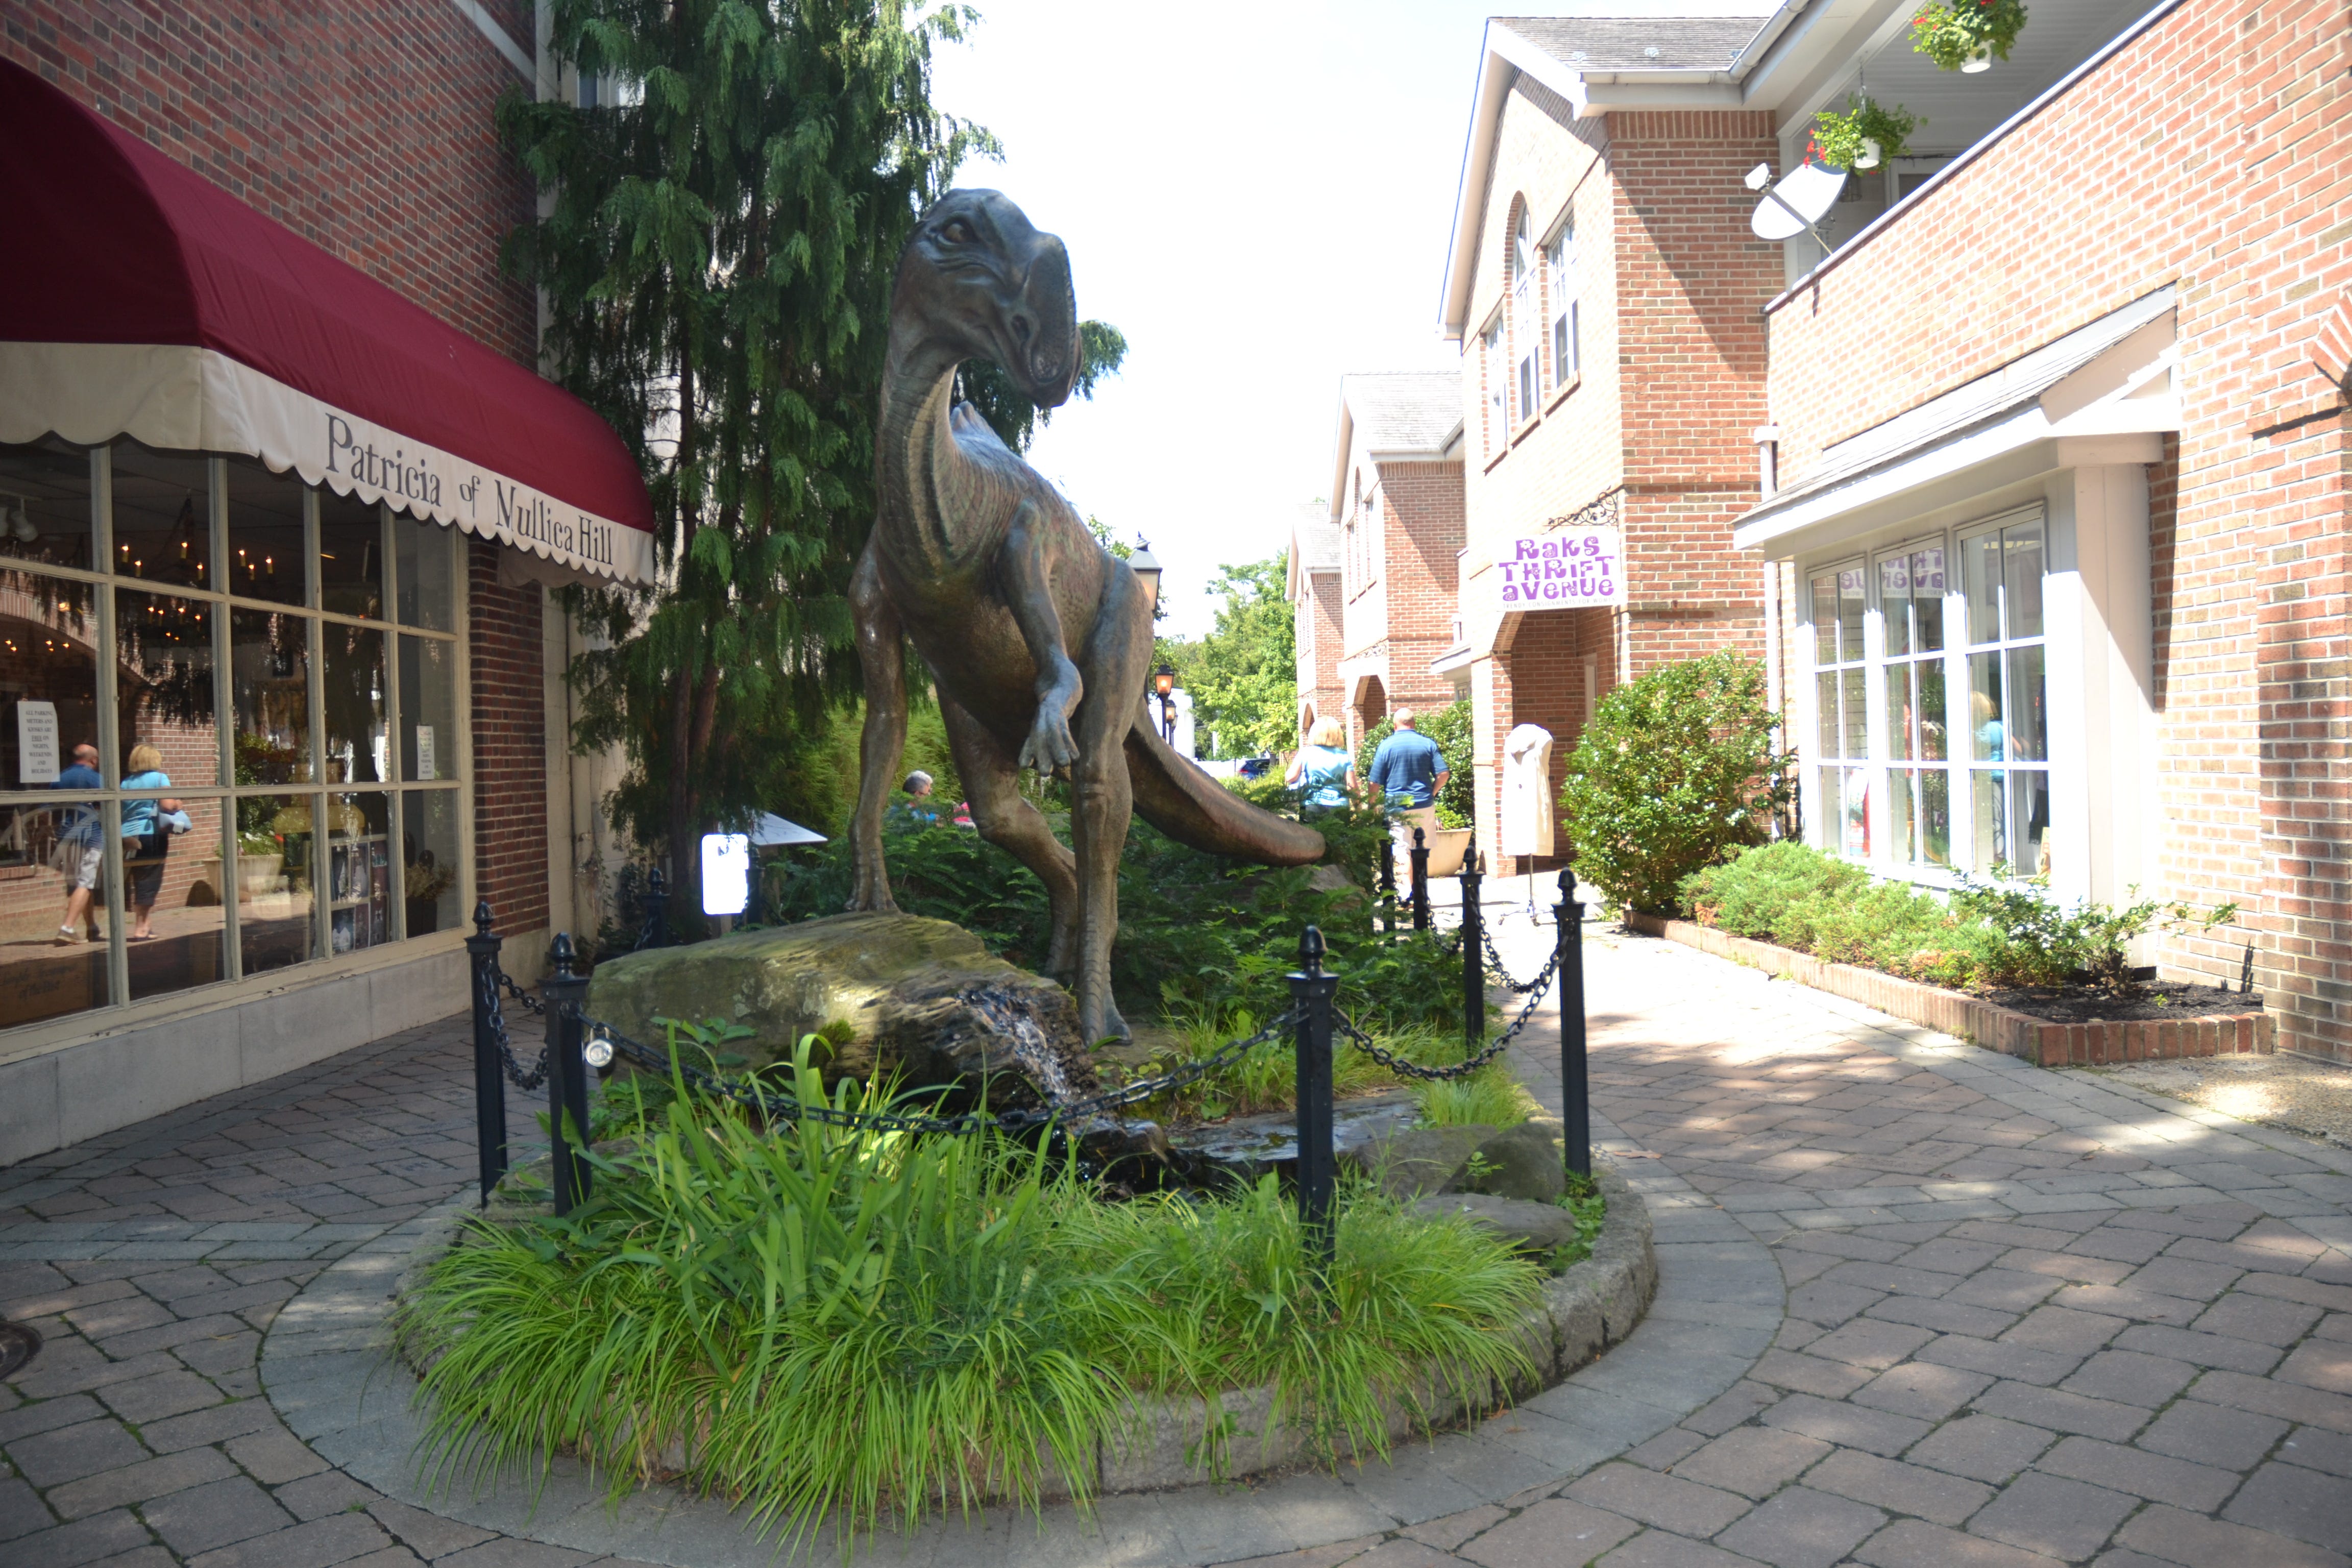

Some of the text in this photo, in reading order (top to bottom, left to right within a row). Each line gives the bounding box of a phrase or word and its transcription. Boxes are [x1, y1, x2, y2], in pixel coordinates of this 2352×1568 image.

[325, 412, 612, 565] Patricia of Nullica Hill
[1529, 599, 1576, 607] CONSIGNMENTS
